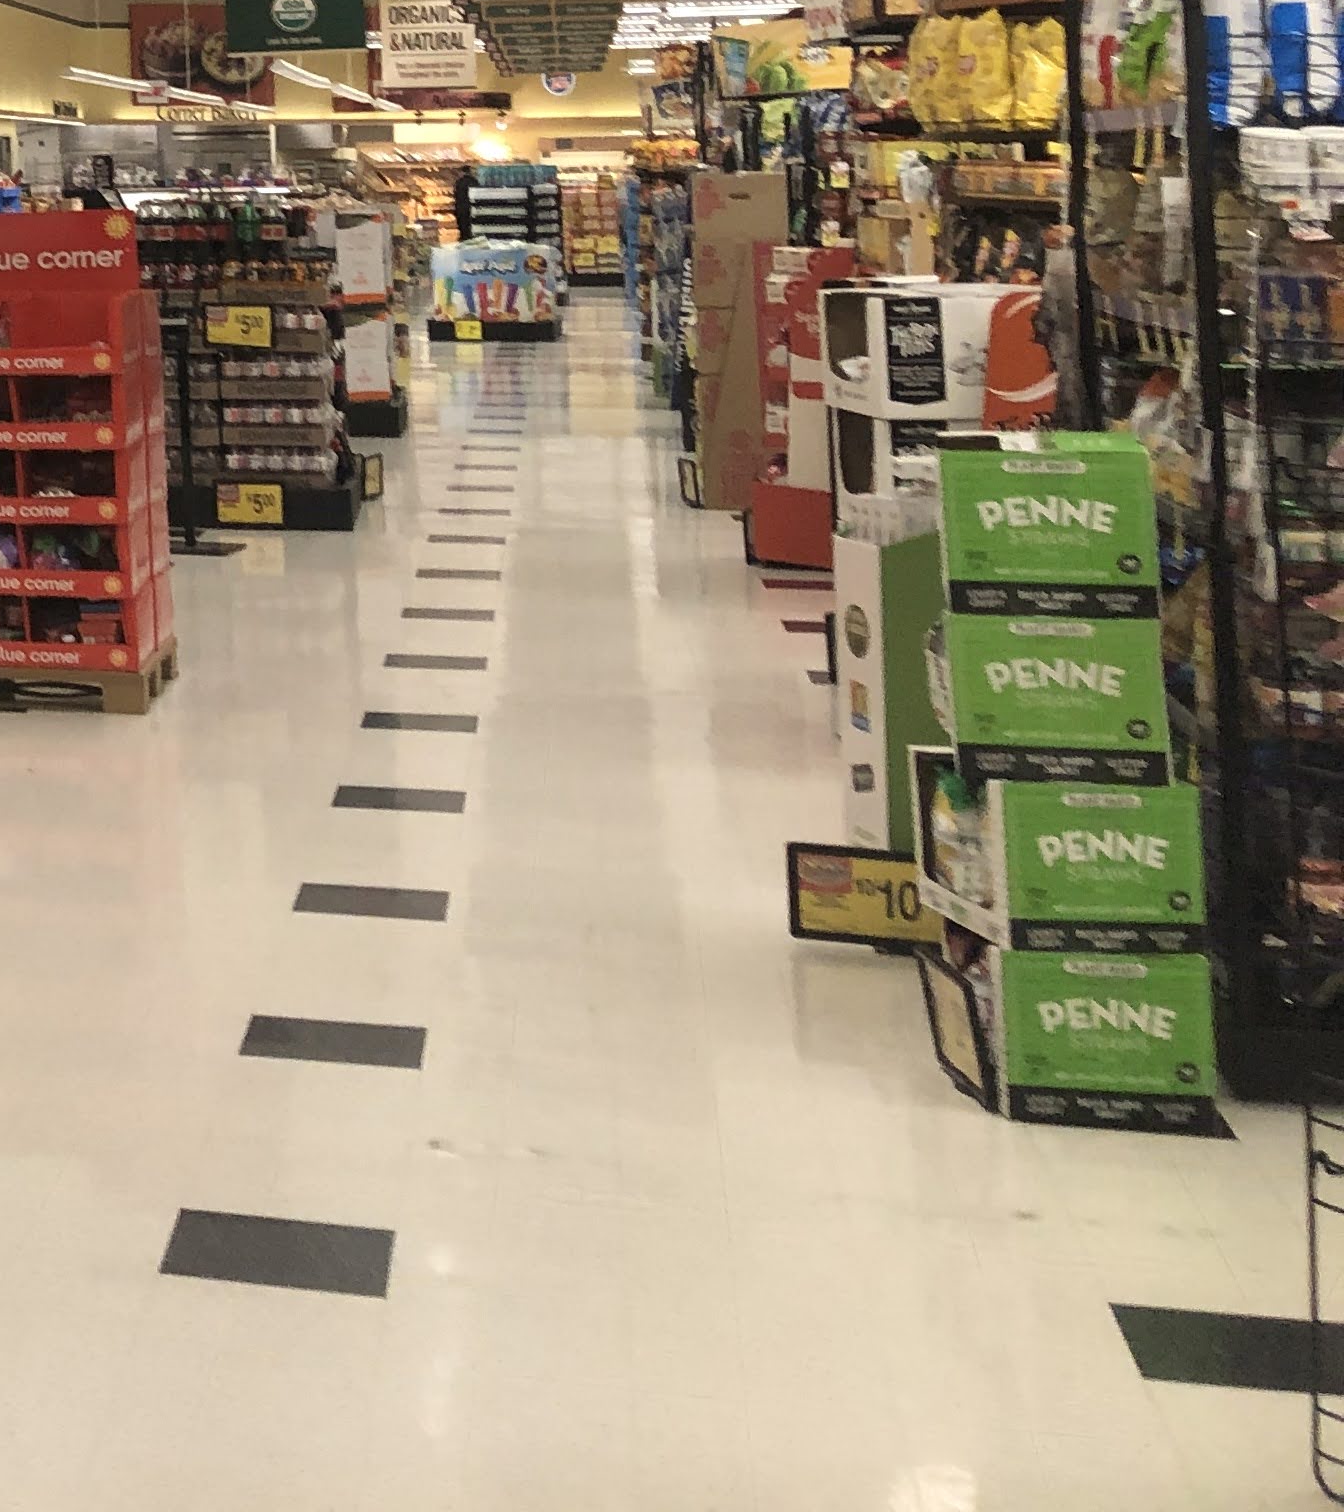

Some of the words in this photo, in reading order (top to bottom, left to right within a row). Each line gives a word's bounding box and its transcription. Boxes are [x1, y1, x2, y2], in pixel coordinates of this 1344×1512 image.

[37, 246, 125, 272] corner
[13, 355, 65, 371] corner
[16, 428, 68, 445] corner
[18, 502, 70, 519] corner
[976, 494, 1120, 535] PENNE
[23, 576, 75, 592] corner
[29, 649, 81, 665] corner
[984, 657, 1127, 699] PENNE
[1036, 829, 1170, 871] PENNE
[1037, 998, 1177, 1042] PENNE
